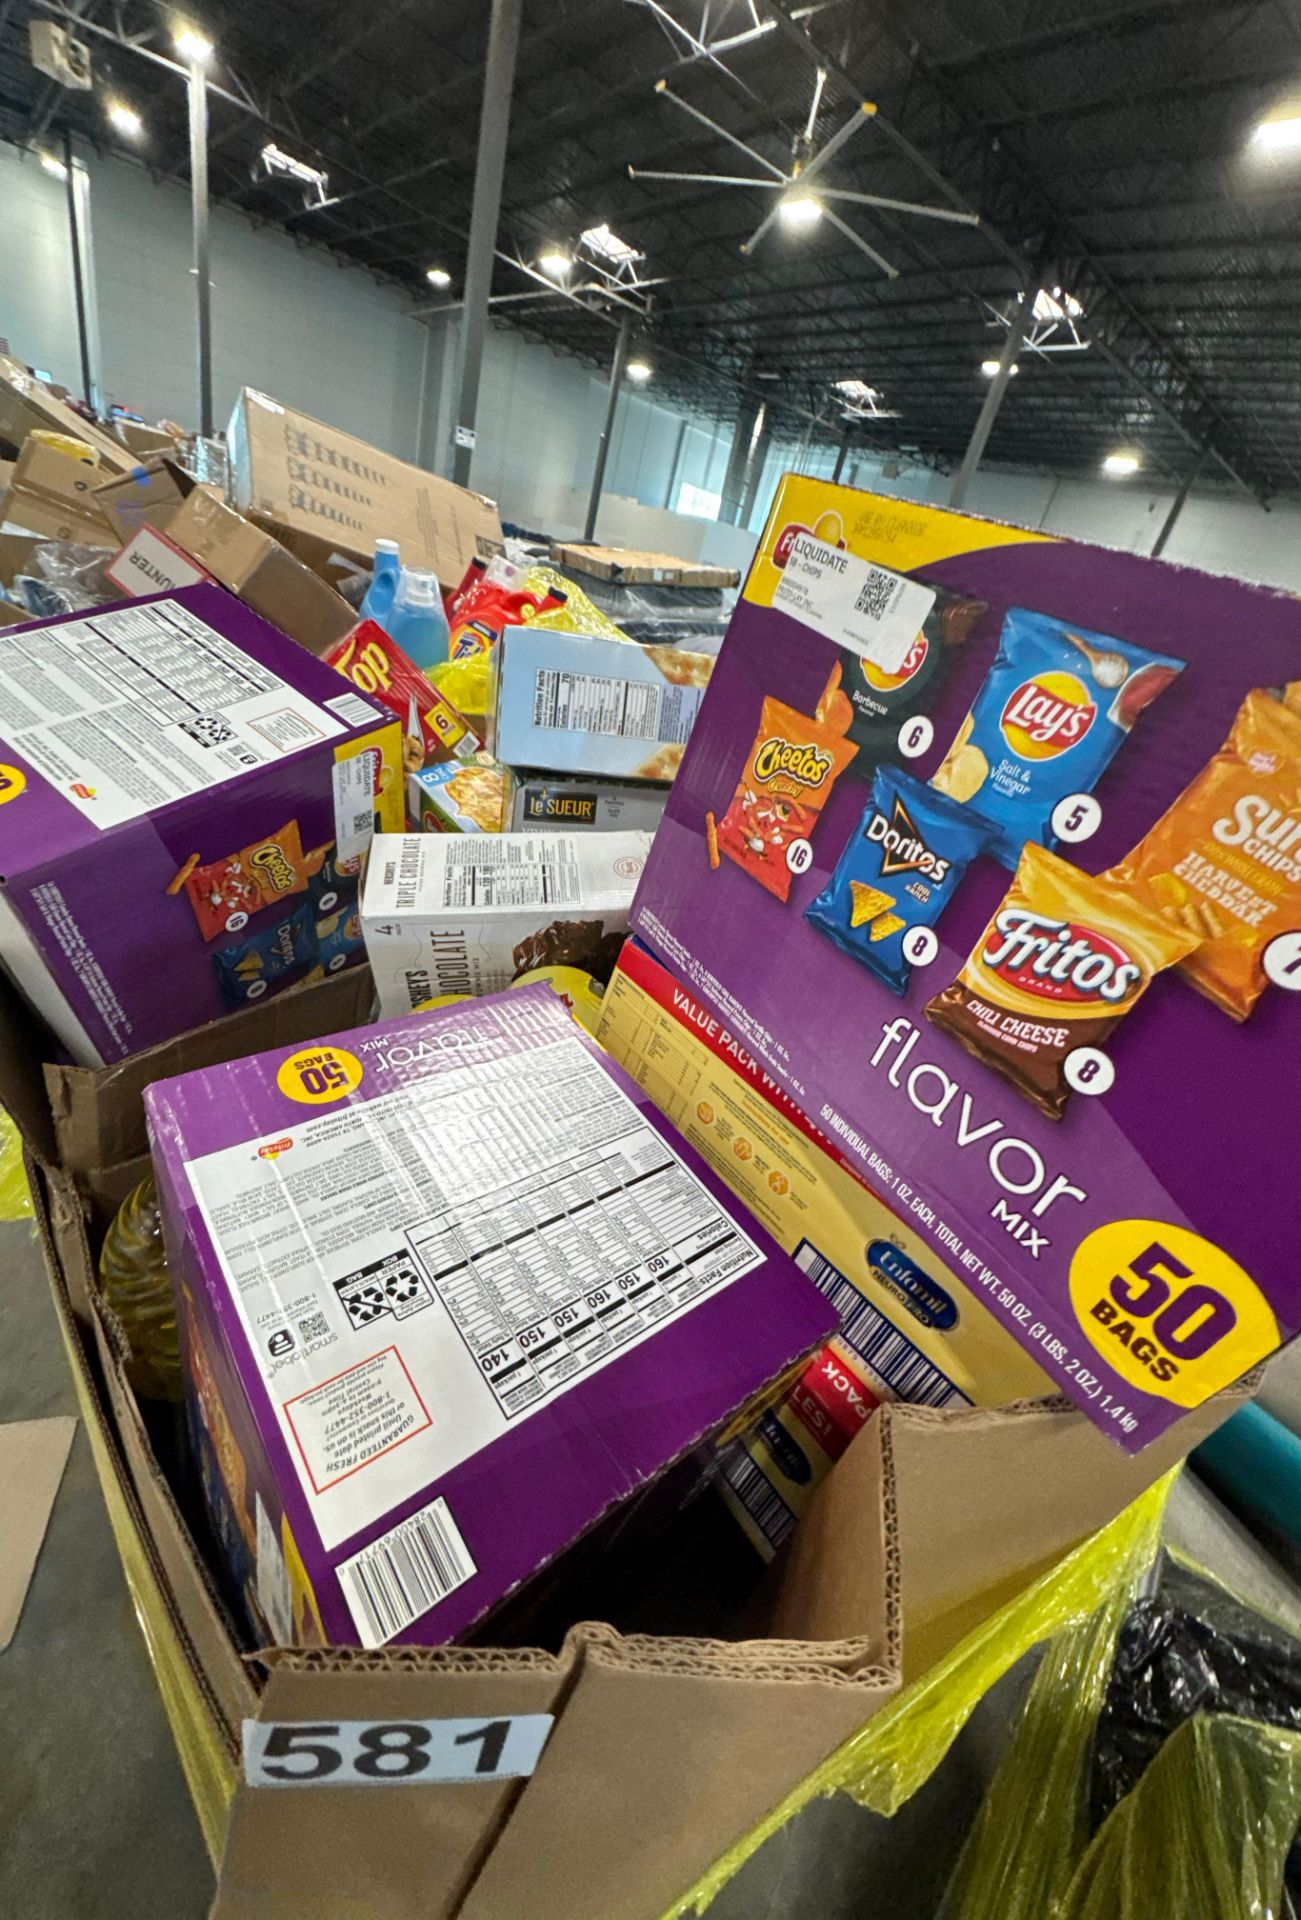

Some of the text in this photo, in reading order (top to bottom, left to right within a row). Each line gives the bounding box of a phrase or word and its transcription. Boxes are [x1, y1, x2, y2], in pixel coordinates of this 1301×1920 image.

[794, 538, 848, 574] LIQUIDATE
[534, 670, 545, 726] Nutrition Facts
[559, 673, 570, 728] Calories 70
[853, 689, 888, 715] Barbecue
[436, 715, 448, 729] 6
[1006, 696, 1092, 741] Lay's
[908, 725, 923, 746] 6
[362, 753, 371, 797] LIQUIDATE
[422, 769, 439, 782] 8
[758, 739, 831, 786] Cheetos
[998, 759, 1030, 782] Salt &
[990, 767, 1030, 794] Vinegar
[530, 799, 543, 816] Le
[546, 800, 592, 816] SUEUR
[1068, 805, 1089, 829] 5
[790, 847, 807, 864] 16
[867, 814, 949, 880] Doritos
[1243, 839, 1301, 882] CHIPS
[251, 844, 295, 892] Cheetos
[384, 862, 396, 885] HERSHEY'S
[396, 838, 421, 908] TRIPLE CHOCOLATE
[905, 885, 929, 902] RANCH
[914, 882, 930, 896] COOL
[1174, 864, 1262, 926] CHEDDAR
[1182, 851, 1277, 915] HARVEST
[230, 913, 245, 929] 16
[375, 924, 393, 935] 4
[276, 923, 296, 965] Doritos
[917, 938, 926, 954] 8
[982, 909, 1141, 1000] Fritos
[430, 930, 472, 998] HOCOLATE
[1018, 977, 1062, 994] BRAND
[674, 988, 757, 1074] VALUE PACK
[966, 1000, 1070, 1048] CHILI CHEESE
[360, 1036, 389, 1052] MIX
[294, 1052, 334, 1070] BAGS
[1077, 1058, 1101, 1084] 8
[300, 1062, 349, 1095] 50
[867, 1017, 1088, 1219] flavor
[989, 1198, 1052, 1260] MIX
[378, 1259, 406, 1276] PAPER
[379, 1255, 398, 1266] BOX
[699, 1248, 754, 1285] Nutrition Facts
[817, 1104, 1138, 1432] 50 INDIVIDUAL BAGS: 1 OZ. EACH, TOTAL NET WT. 50 OZ. (3 LBS. 2 OZ.) 1.4 kg
[346, 1272, 363, 1283] BAG
[659, 1272, 678, 1288] package
[880, 1250, 945, 1313] Enfamil
[481, 1216, 728, 1372] Calories 160 150 160 150 150 140
[629, 1289, 650, 1306] package
[870, 1268, 929, 1323] NEURO PRO
[1108, 1241, 1237, 1361] 50
[598, 1307, 617, 1323] package
[566, 1326, 586, 1343] package
[1088, 1298, 1181, 1384] BAGS
[532, 1347, 553, 1365] package
[329, 1378, 370, 1405] Central Time
[492, 1370, 516, 1389] package
[822, 1360, 871, 1420] PACK
[325, 1391, 390, 1434] 1-800-352-4477
[338, 1393, 372, 1415] Weekdays
[380, 1407, 396, 1420] this
[397, 1402, 404, 1410] or
[334, 1414, 402, 1458] Until printed date
[357, 1416, 380, 1434] snack
[324, 1443, 335, 1452] us.
[326, 1415, 414, 1472] GUARANTEED FRESH
[337, 1436, 347, 1446] on
[261, 1719, 512, 1780] 581
